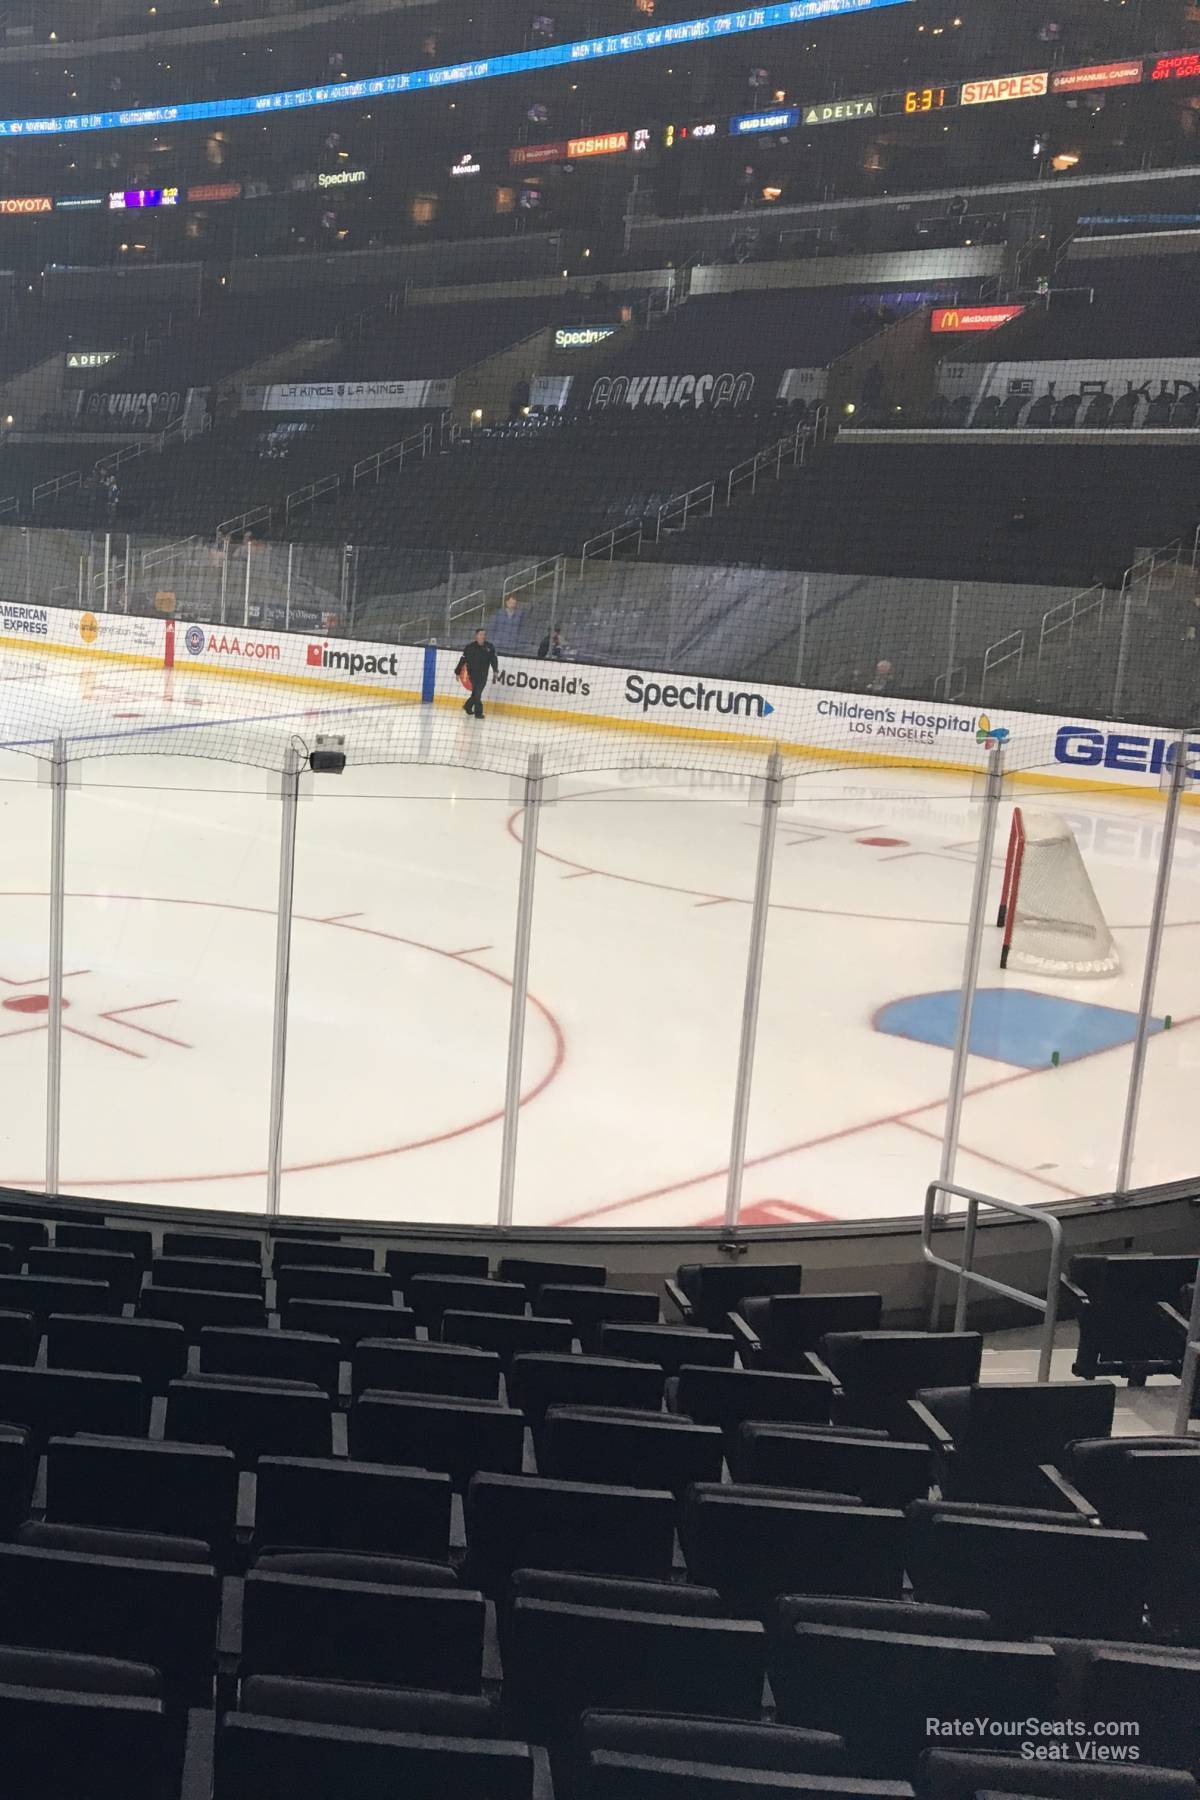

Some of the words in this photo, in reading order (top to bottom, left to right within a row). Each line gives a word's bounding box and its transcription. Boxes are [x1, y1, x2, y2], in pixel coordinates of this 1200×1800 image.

[593, 43, 603, 53] THE
[646, 34, 661, 44] NEW
[736, 16, 746, 27] TO
[748, 12, 765, 25] LIFE
[1152, 70, 1169, 80] ON
[1176, 65, 1200, 77] GOA
[1157, 55, 1199, 71] SHOTS
[1109, 68, 1138, 79] CASINO
[963, 75, 1044, 102] STAPLES
[905, 88, 944, 113] 6:31
[822, 102, 874, 120] DELTA
[634, 129, 650, 140] STL
[569, 136, 627, 155] TOSHIBA
[634, 140, 646, 150] LA
[318, 170, 366, 188] Spectrum
[556, 328, 615, 348] Spectru
[81, 354, 117, 366] DELT
[281, 387, 296, 398] LA
[300, 386, 334, 397] KINGS
[347, 385, 364, 396] LA
[370, 384, 404, 395] KINGS
[4, 619, 48, 634] EXPRESS
[208, 634, 280, 660] AAA.com
[322, 641, 398, 676] impact
[492, 670, 590, 696] McDonald's
[624, 674, 764, 718] Spectrum
[817, 700, 896, 724] Children's
[901, 710, 976, 735] Hospital
[849, 722, 872, 734] LOS
[877, 726, 934, 744] ANGELES
[1055, 726, 1200, 781] GEIC
